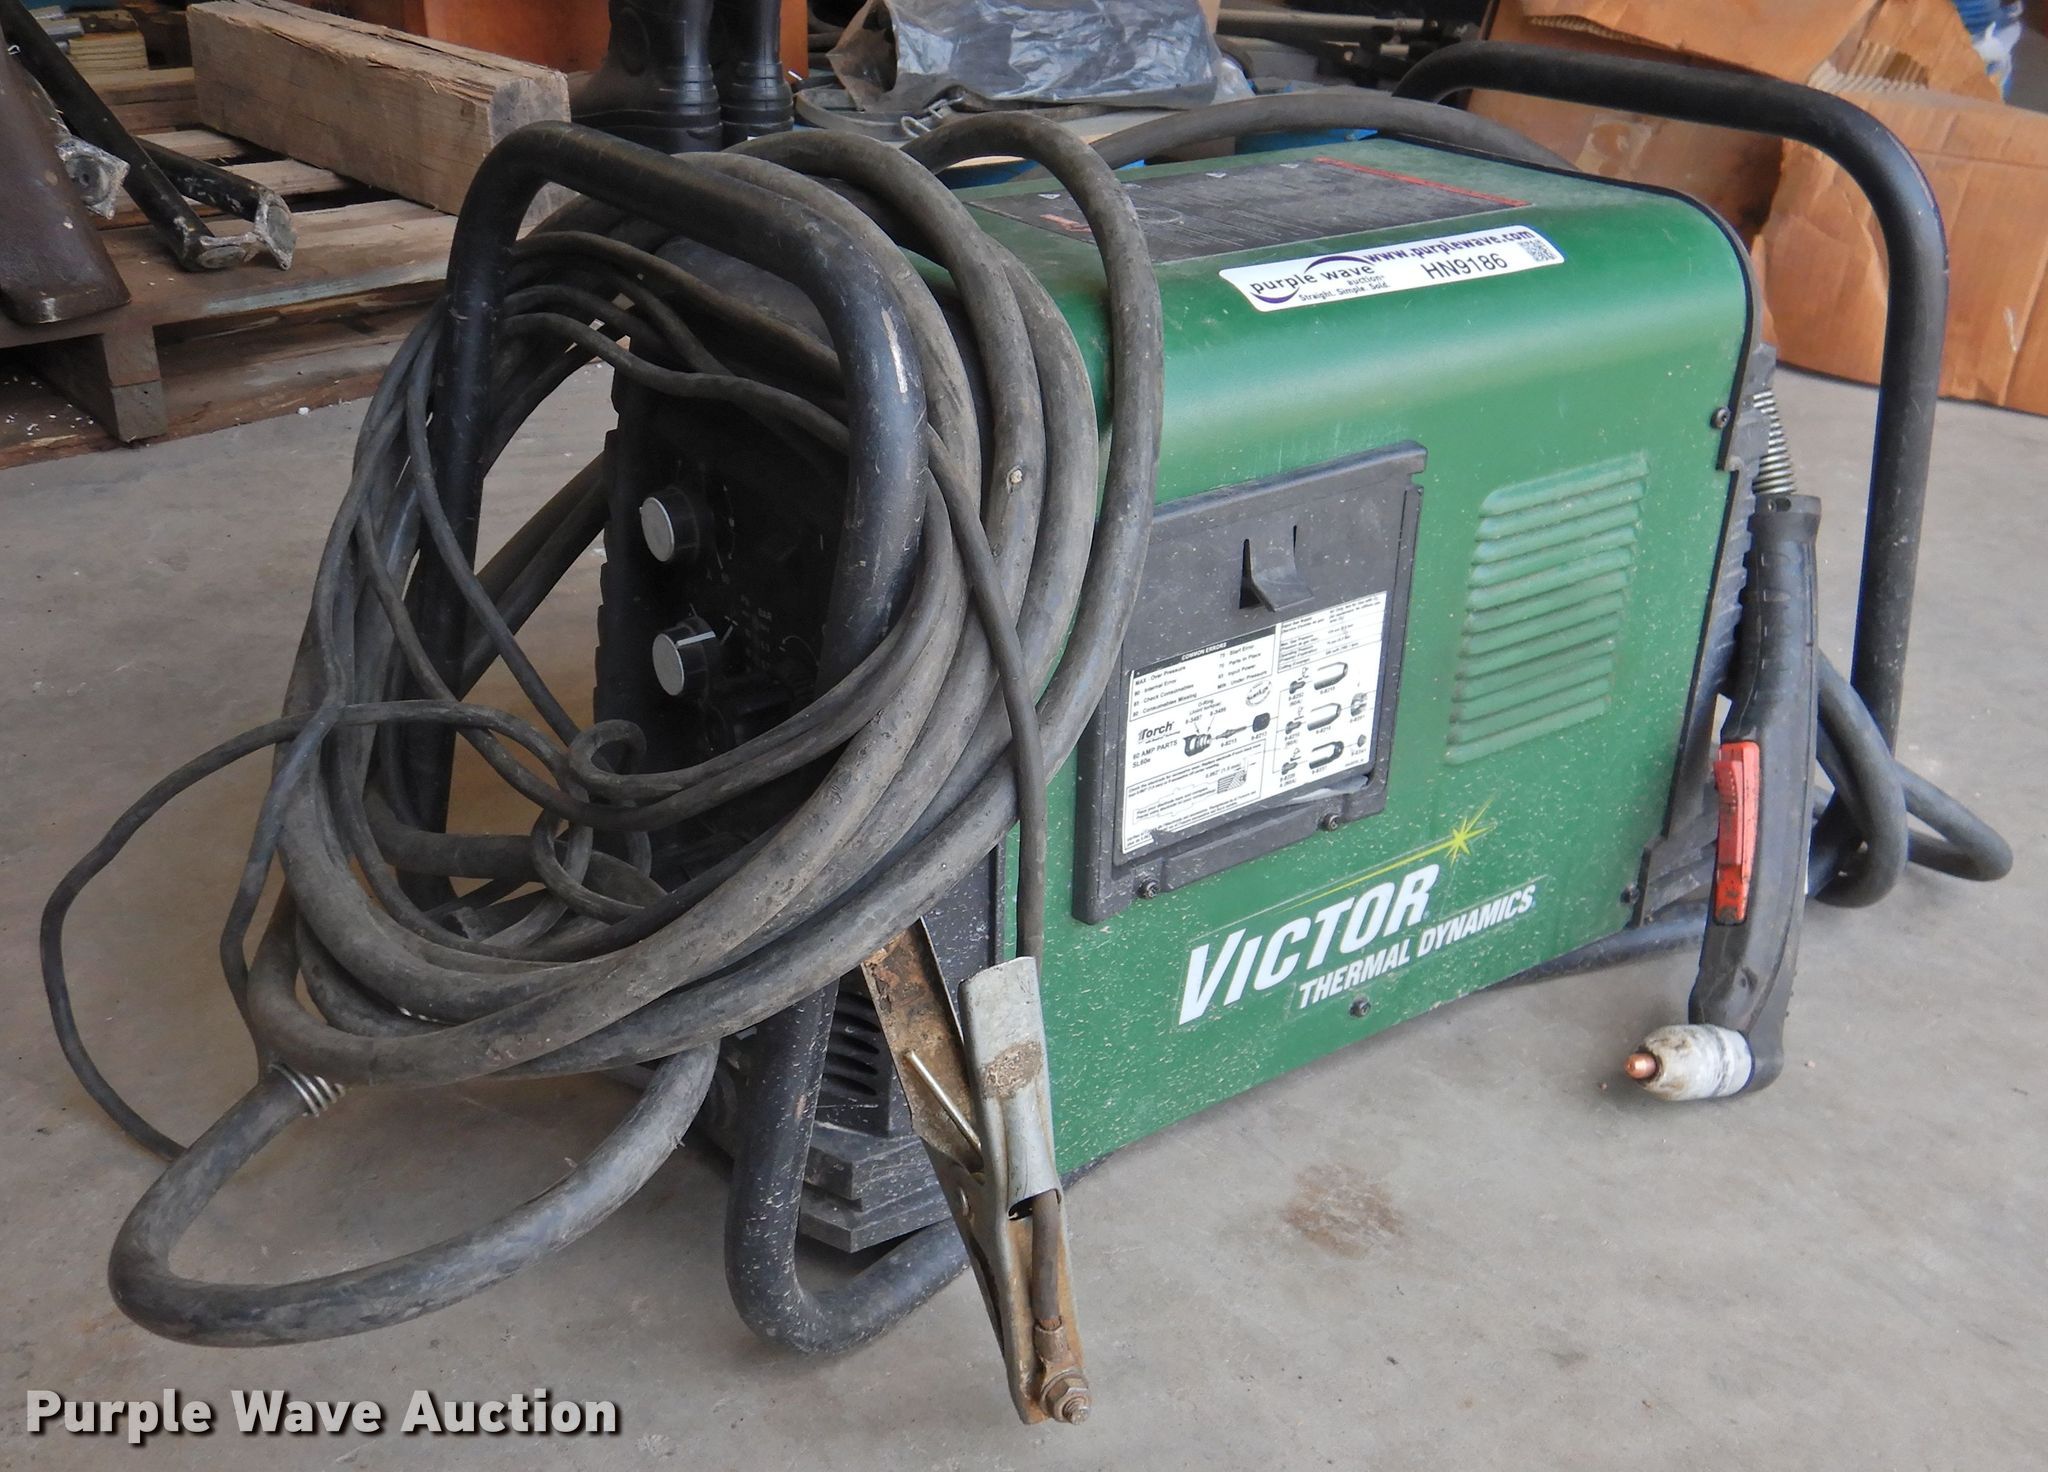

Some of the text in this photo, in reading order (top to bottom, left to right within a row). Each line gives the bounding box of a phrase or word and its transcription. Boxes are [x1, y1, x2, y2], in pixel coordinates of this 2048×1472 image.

[1365, 229, 1535, 263] www.purplewave.com
[1250, 264, 1376, 296] purple wave
[1420, 253, 1508, 280] HN9186
[1182, 642, 1227, 661] COMMON ERRORS
[1157, 739, 1178, 752] PARTS
[1178, 863, 1440, 1026] VICTOR
[1299, 884, 1537, 1010] THERMAL DYNAMICS
